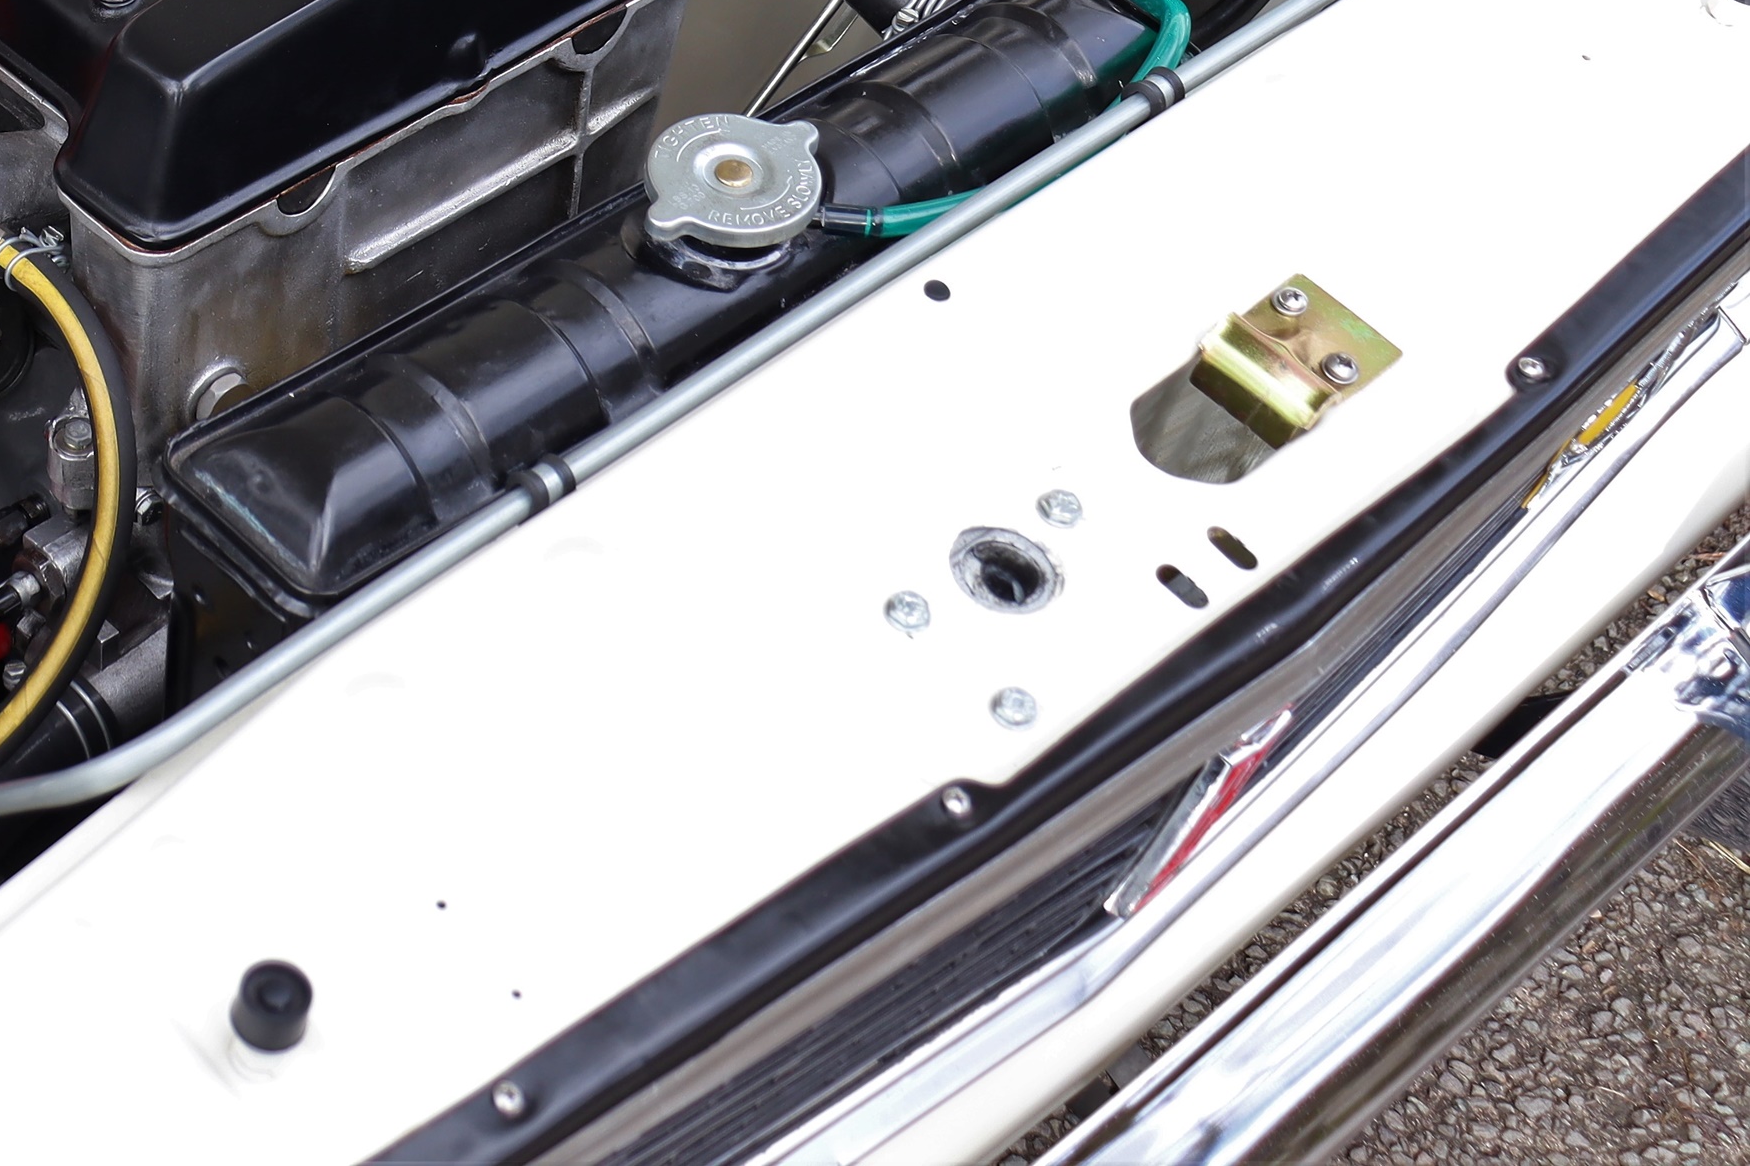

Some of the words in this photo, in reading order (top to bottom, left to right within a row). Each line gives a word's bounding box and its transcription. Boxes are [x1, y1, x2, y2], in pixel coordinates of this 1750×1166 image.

[655, 116, 730, 160] TIGHTEN
[708, 205, 791, 226] REMOVE
[788, 158, 814, 210] SLOWLY
